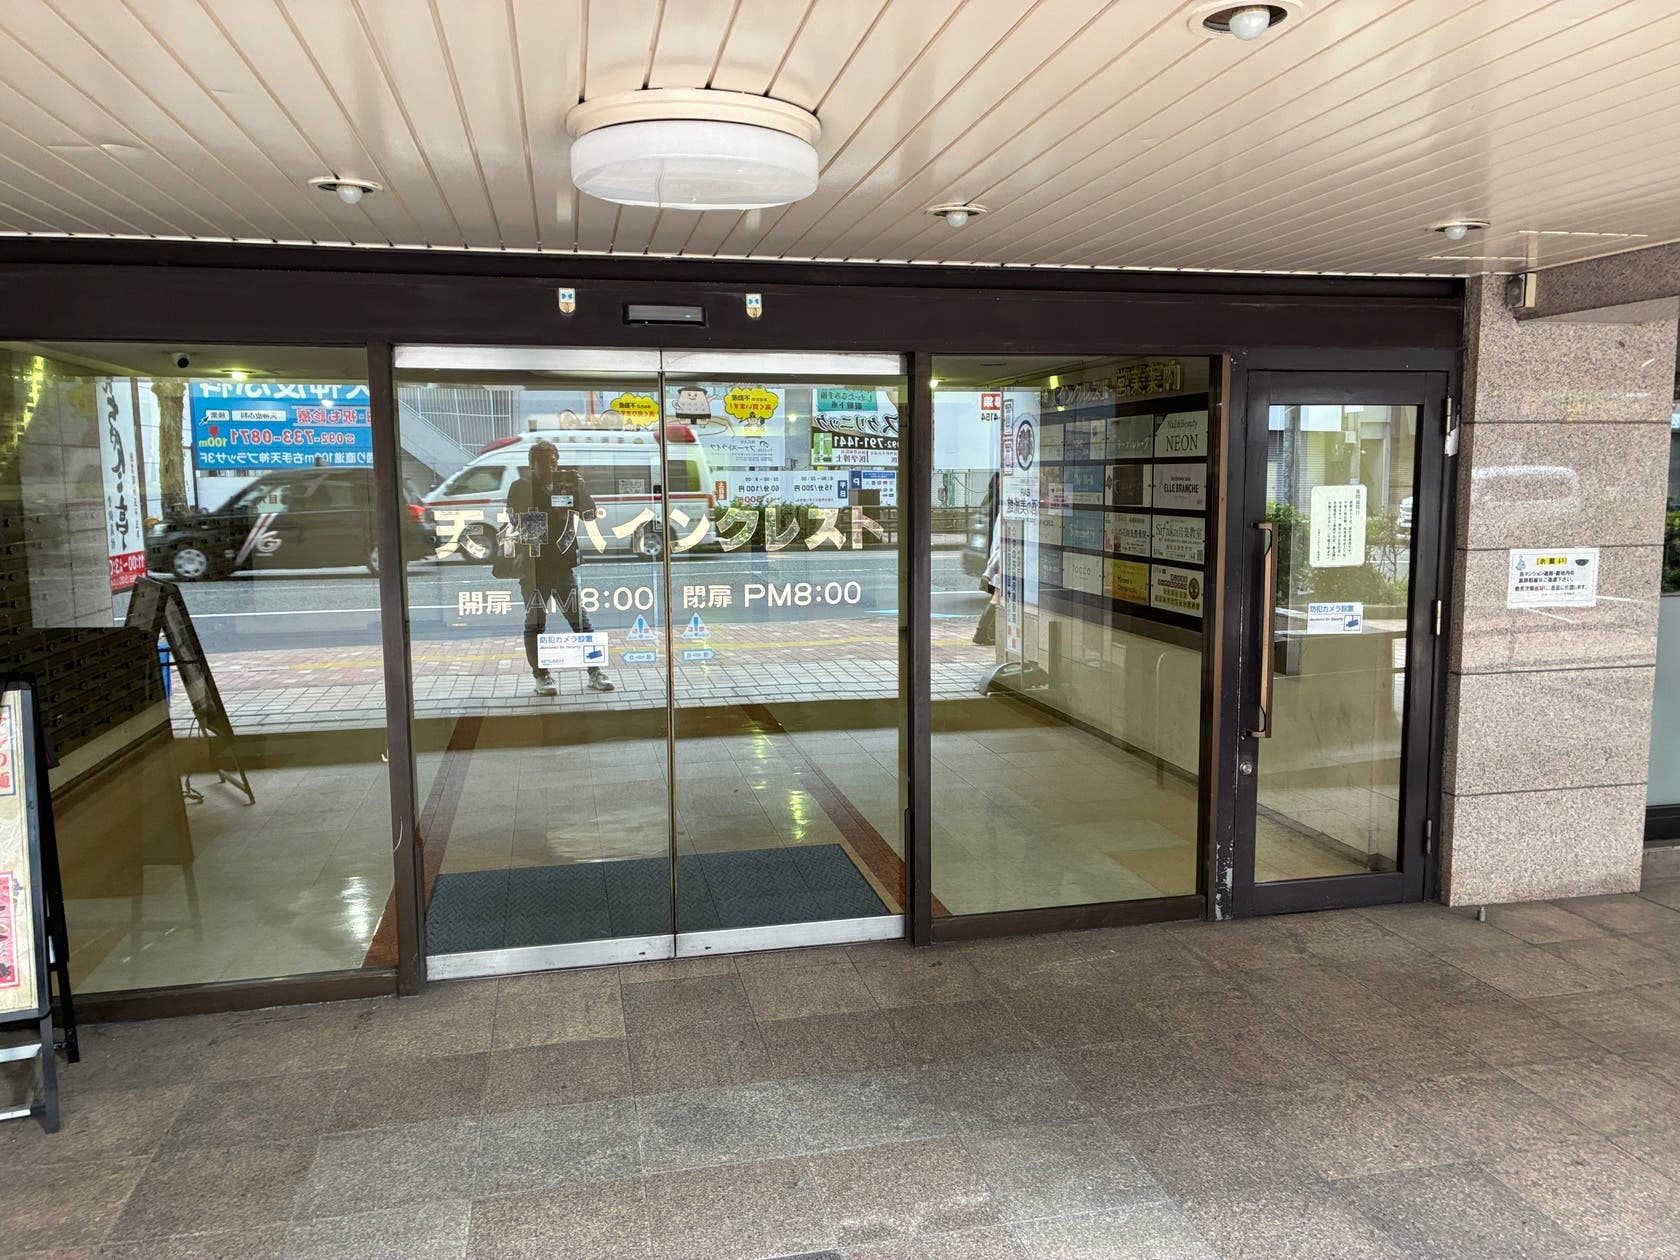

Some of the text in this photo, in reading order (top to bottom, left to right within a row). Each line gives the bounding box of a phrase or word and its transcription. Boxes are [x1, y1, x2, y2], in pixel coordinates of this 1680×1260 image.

[1166, 433, 1198, 453] NEON
[433, 506, 885, 559] 天神パインクレスト
[458, 585, 655, 616] 開扉 AM8:00
[683, 581, 862, 609] 閉扉 PM8:00
[1309, 604, 1354, 614] 防犯カメラ設置
[539, 634, 593, 644] 防犯カメラ設置
